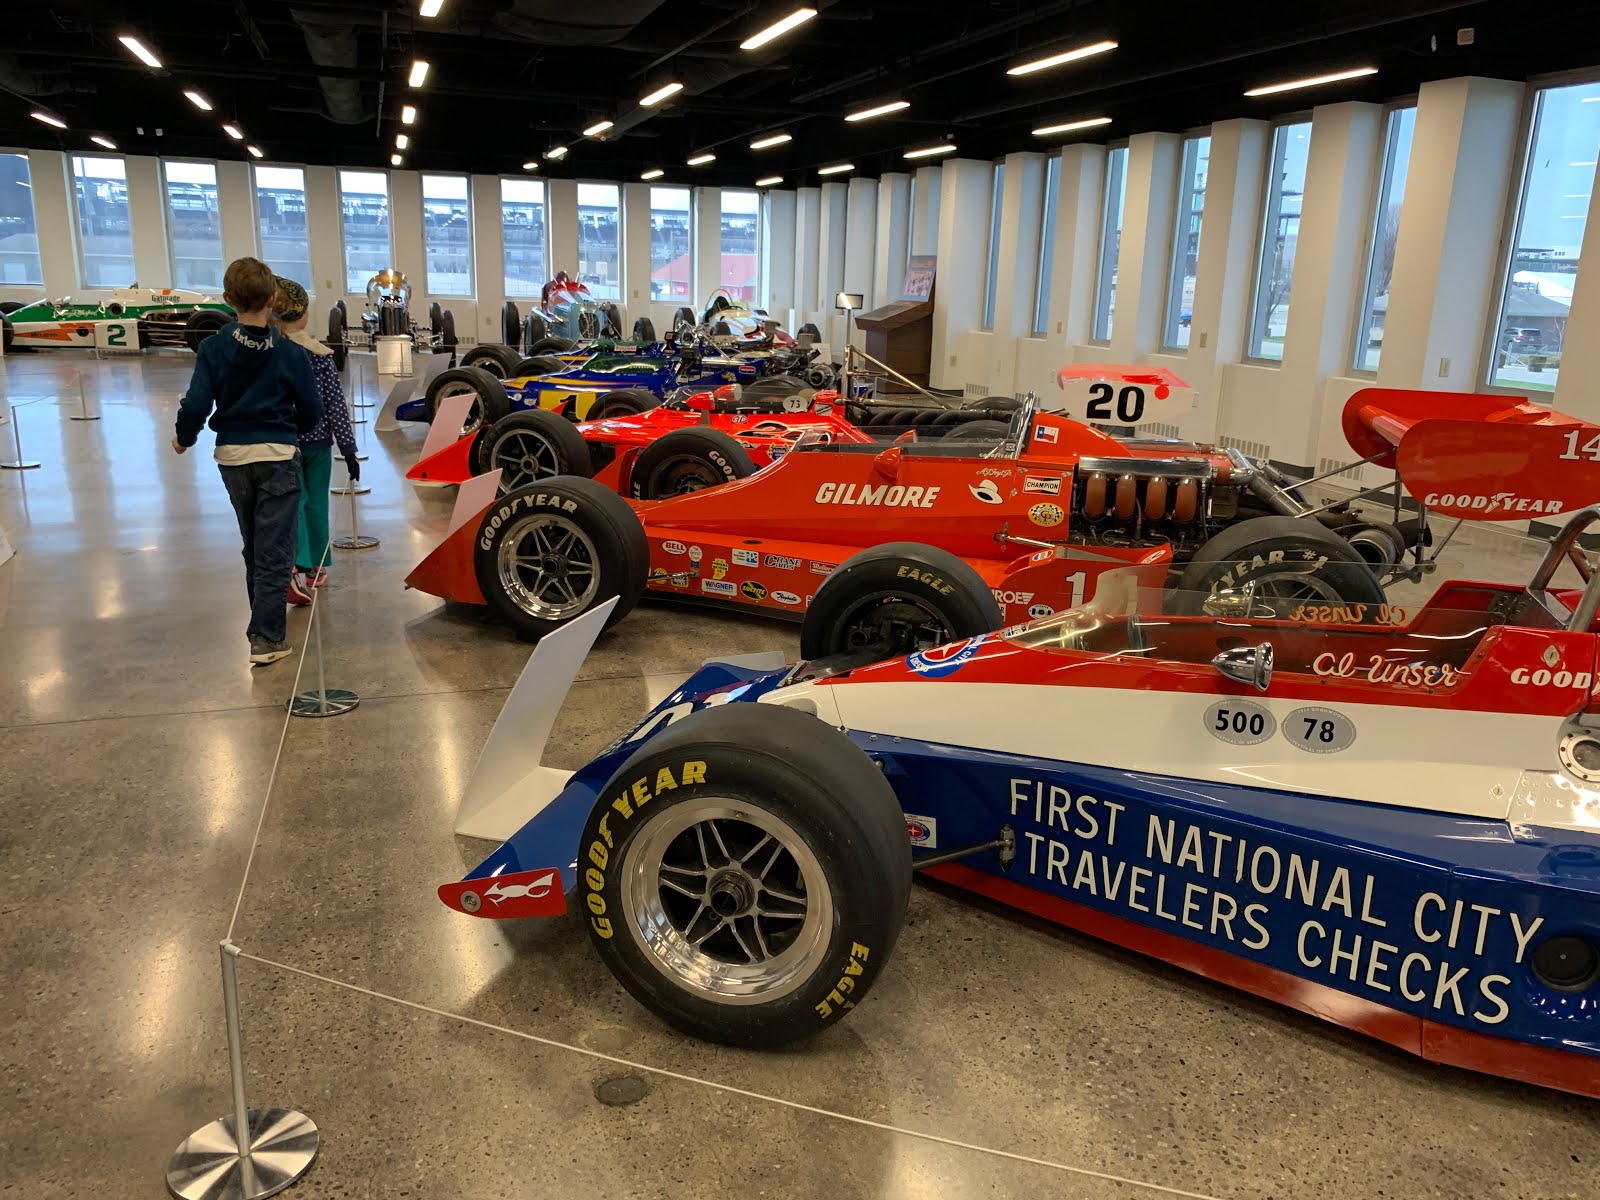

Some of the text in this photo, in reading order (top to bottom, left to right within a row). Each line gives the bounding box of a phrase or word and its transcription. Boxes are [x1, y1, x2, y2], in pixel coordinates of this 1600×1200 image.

[151, 294, 181, 302] Gatorade
[107, 324, 127, 346] 2
[232, 328, 264, 350] Hurley
[560, 394, 582, 423] 1
[789, 400, 801, 409] 73
[1086, 383, 1145, 422] 20
[733, 414, 747, 424] STP
[1559, 430, 1600, 462] 14
[815, 482, 941, 508] GILMORE
[1026, 481, 1059, 490] CHAMPION
[1424, 492, 1564, 514] GOODYEAR
[480, 493, 578, 551] GOODYEAR
[665, 542, 685, 551] BELL
[704, 580, 734, 591] WAGNER
[741, 584, 767, 595] LOCTITE
[896, 565, 955, 596] EAGLE
[1367, 654, 1458, 687] Unser
[1215, 709, 1265, 735] 500
[1303, 718, 1335, 742] 78
[584, 760, 708, 940] GOODYEAR
[1010, 778, 1125, 845] FIRST
[1146, 814, 1387, 928] NATIONAL
[1414, 892, 1544, 964] CITY
[1025, 831, 1512, 1025] TRAVELERS CHECKS
[814, 940, 870, 1019] EAGLE
